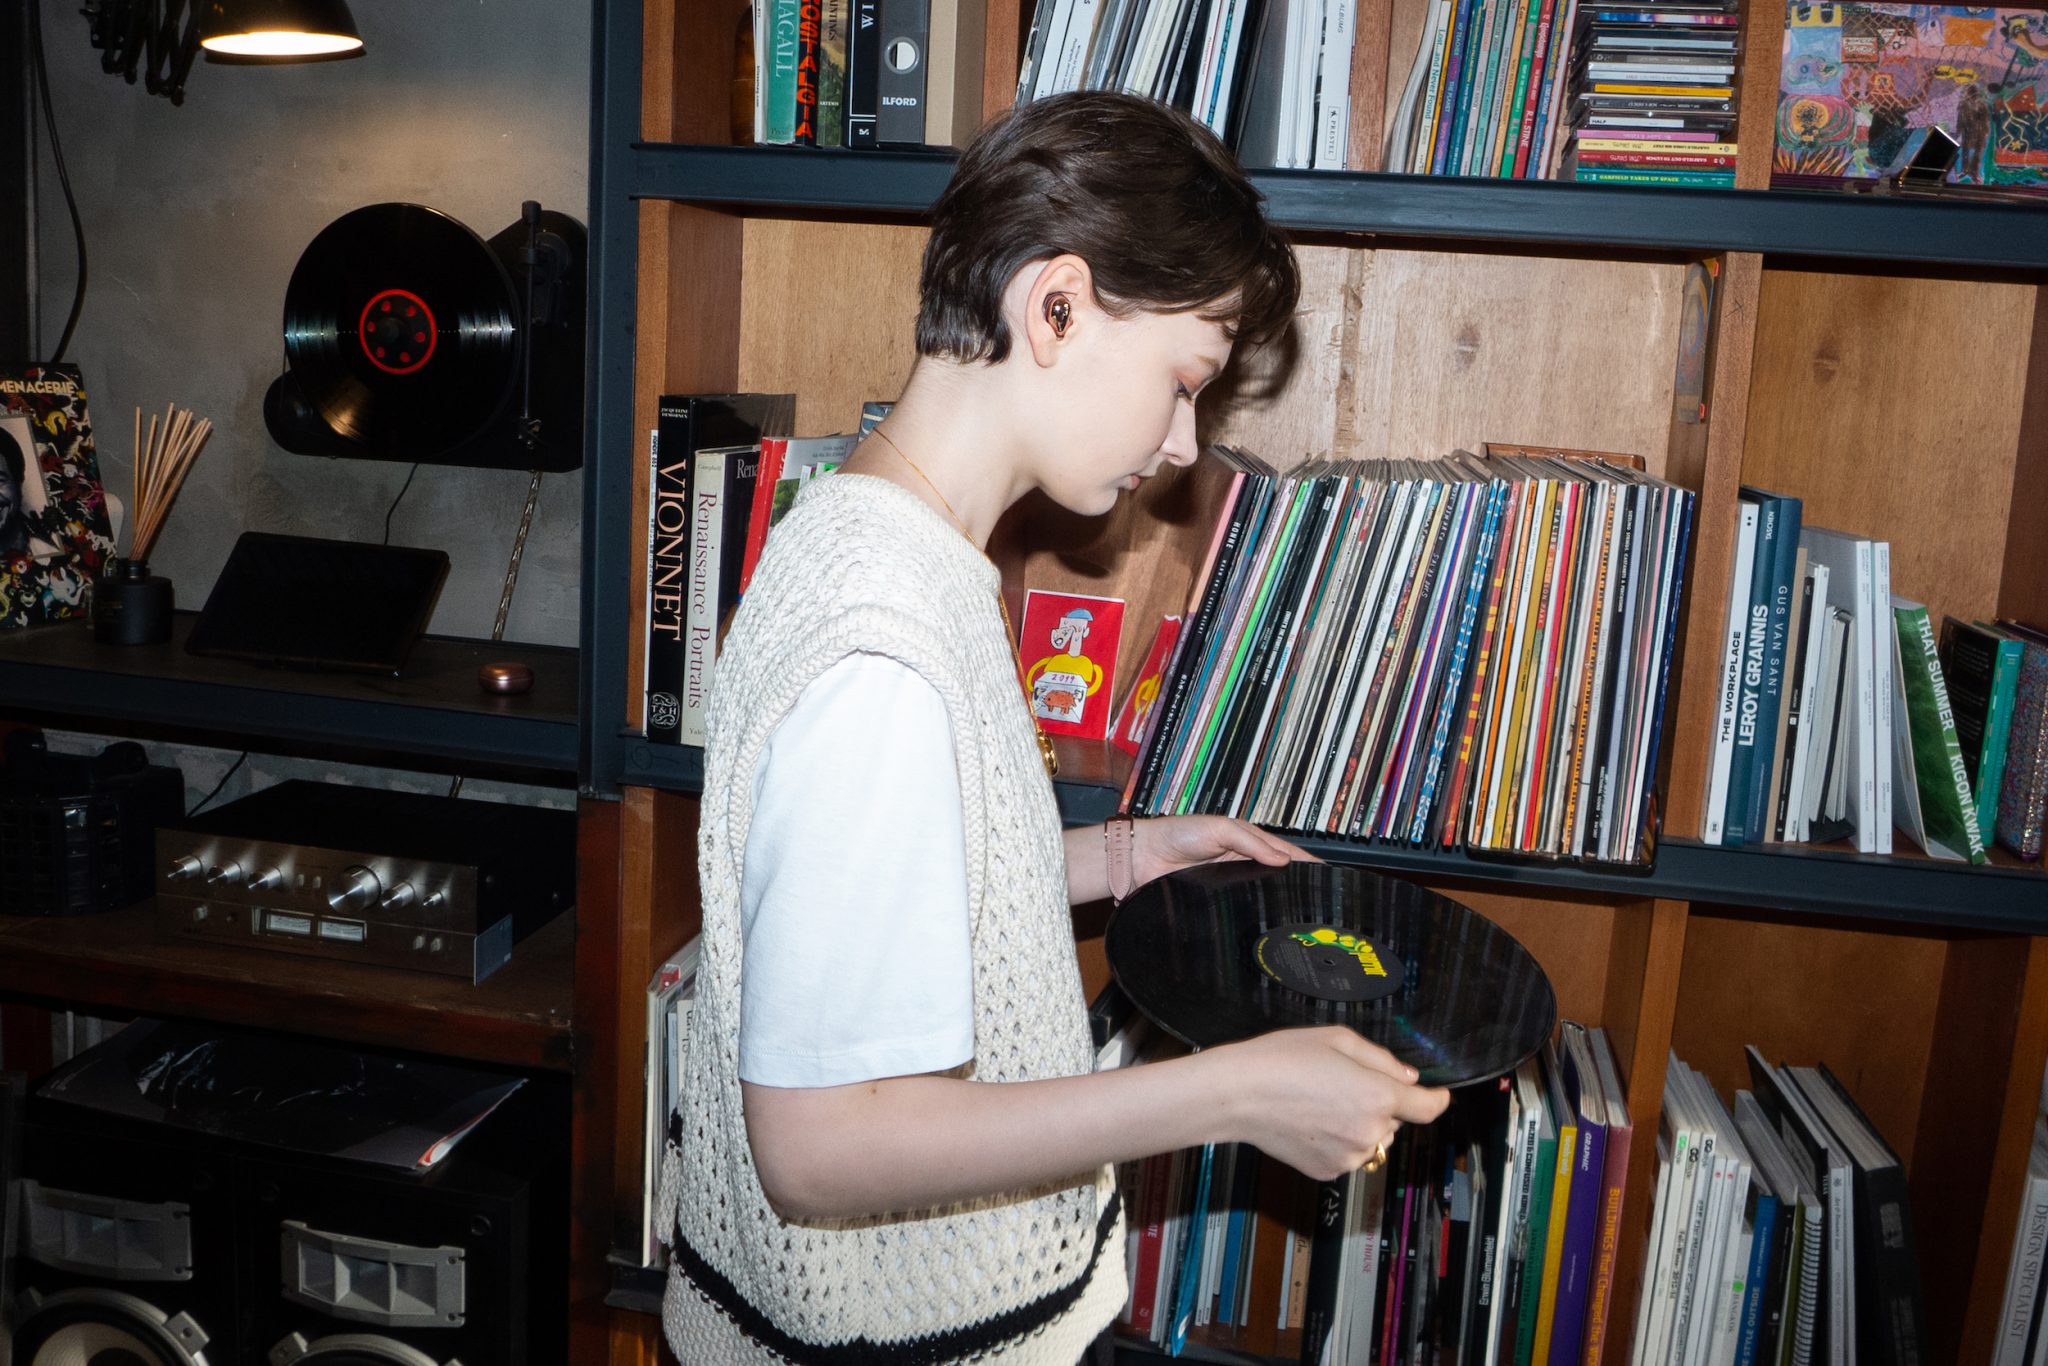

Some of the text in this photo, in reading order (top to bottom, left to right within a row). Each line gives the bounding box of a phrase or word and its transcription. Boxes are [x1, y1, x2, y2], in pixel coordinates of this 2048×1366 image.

[829, 0, 837, 40] AINTINGS
[795, 0, 820, 138] OSTALGIA
[883, 97, 917, 106] ILFORD
[1327, 119, 1336, 155] PRESTEL
[1520, 124, 1531, 147] STINE
[653, 459, 686, 641] VIONNET
[1223, 520, 1242, 549] HONNE
[1549, 508, 1561, 550] MALIBU
[1765, 511, 1775, 541] TASCHEN
[688, 490, 717, 710] Renaissance Portraits
[1765, 584, 1788, 697] GUS VAN SANT
[1915, 614, 1938, 658] THAT
[1051, 673, 1075, 682] 2019
[1720, 630, 1742, 744] THE WORKPLACE
[1736, 603, 1769, 747] LEROY GRANNIS
[1926, 658, 1956, 731] SUMMER
[1948, 753, 1973, 806] KIGON
[1961, 807, 1985, 855] KWAK
[1526, 1120, 1536, 1145] DAZED
[1579, 1130, 1592, 1171] GRAPHIC
[1478, 1234, 1496, 1305] Erwin Blumenfeld
[1589, 1186, 1620, 1343] BUILDINGS that Changed the
[2008, 1202, 2048, 1340] DESIGN SPECIALIST
